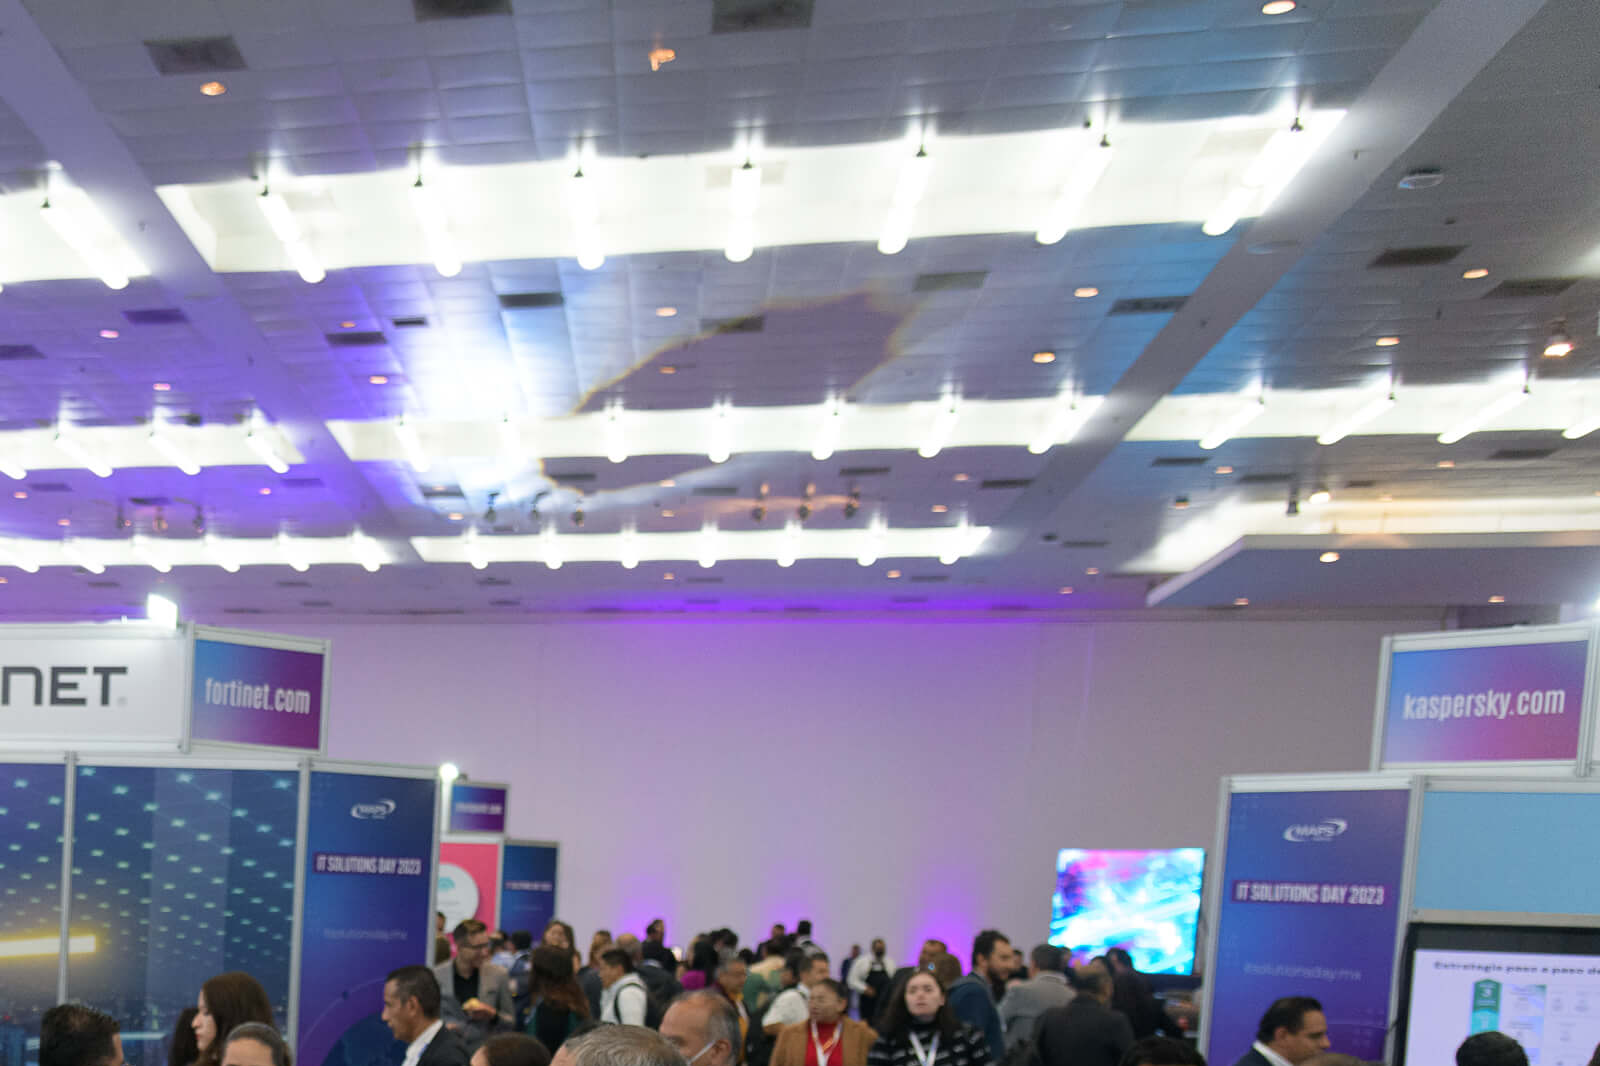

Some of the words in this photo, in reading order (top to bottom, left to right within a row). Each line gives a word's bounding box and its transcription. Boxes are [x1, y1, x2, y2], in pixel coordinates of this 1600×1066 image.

[205, 678, 311, 715] fortinet.com
[1403, 689, 1566, 721] kaspersky.com
[327, 855, 377, 873] SOLUTIONS
[397, 858, 421, 875] 2023
[1236, 883, 1249, 900] IT
[1251, 884, 1318, 903] SOLUTIONS
[1320, 886, 1347, 904] DAY
[1348, 886, 1384, 905] 2023
